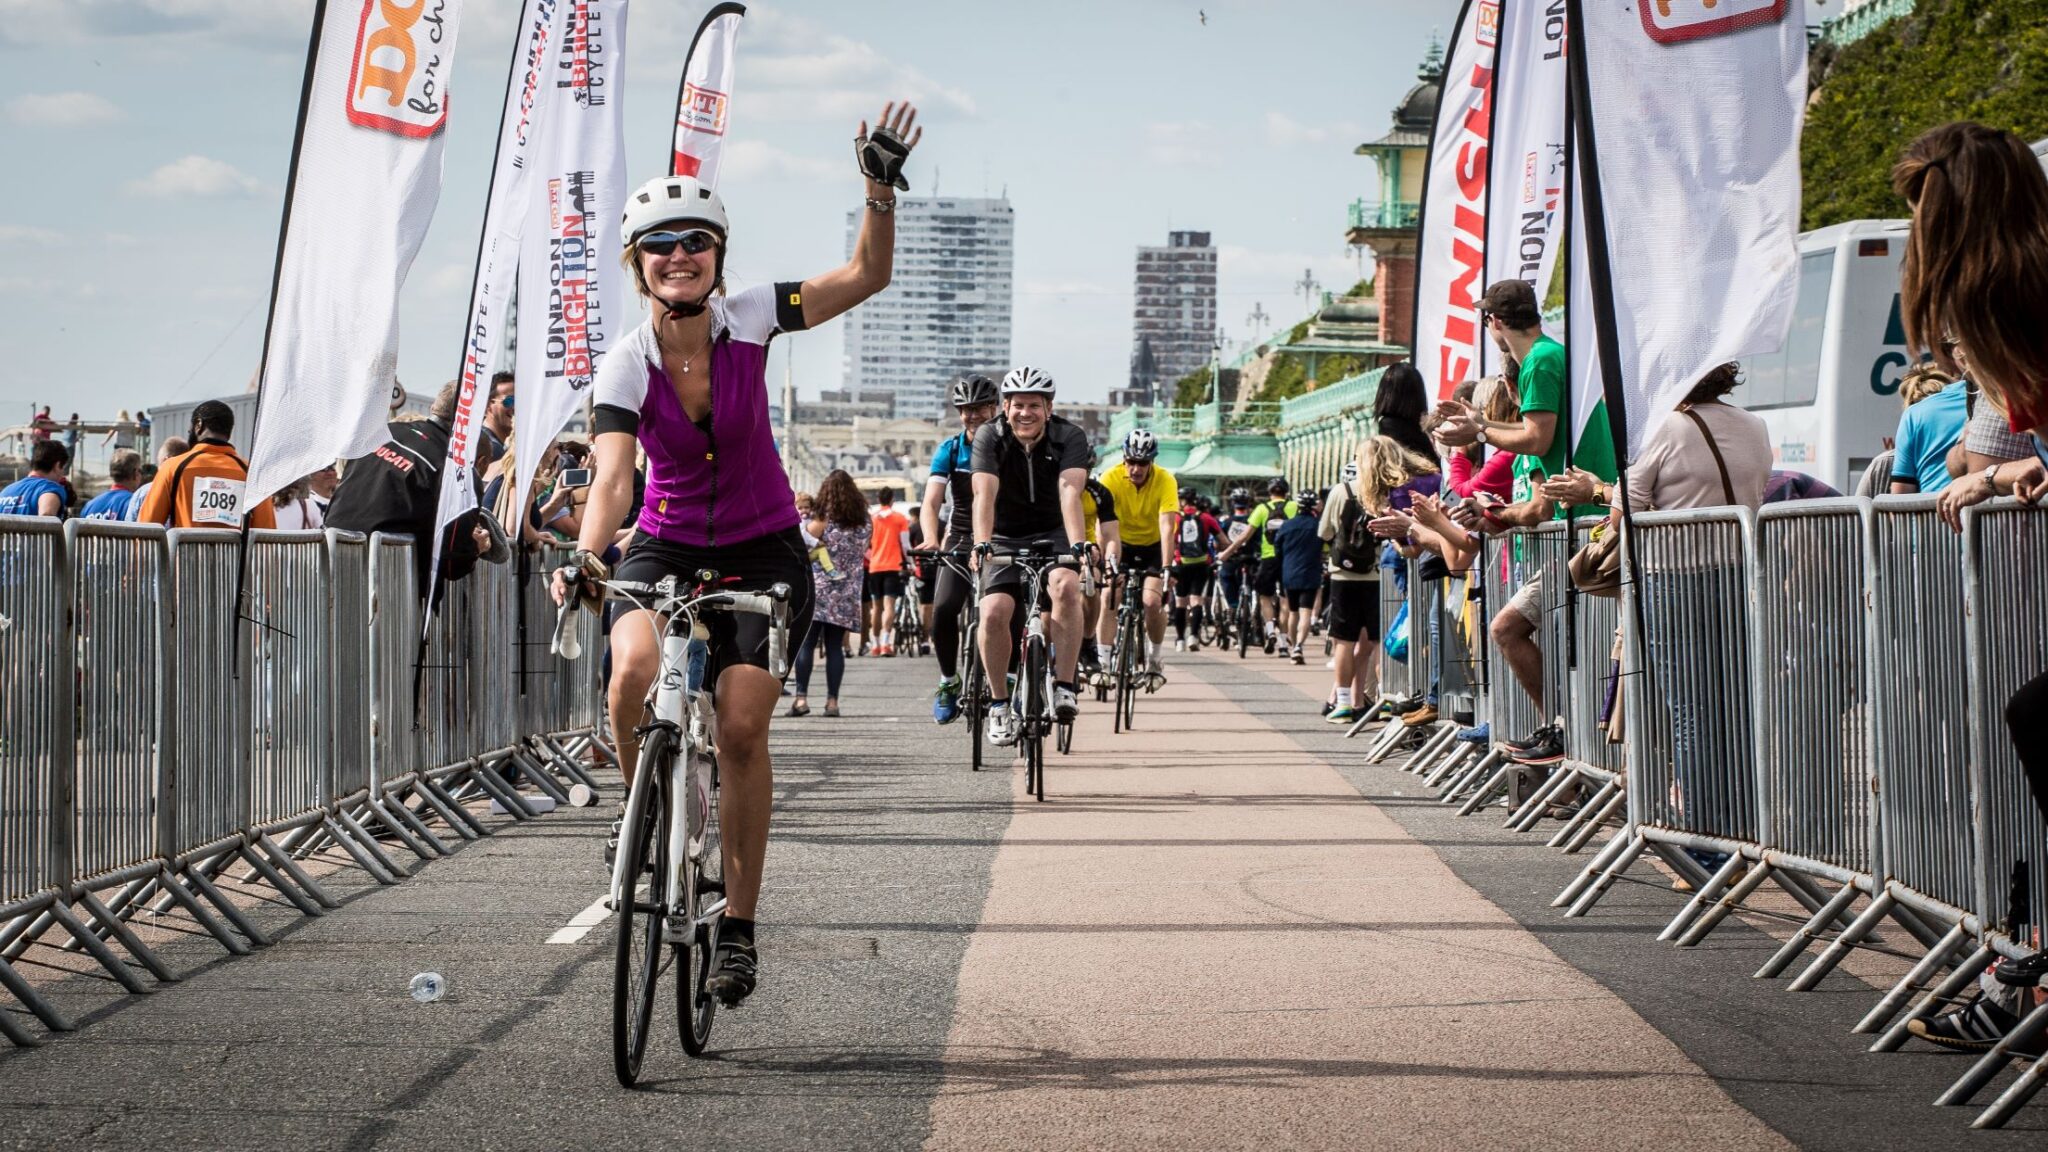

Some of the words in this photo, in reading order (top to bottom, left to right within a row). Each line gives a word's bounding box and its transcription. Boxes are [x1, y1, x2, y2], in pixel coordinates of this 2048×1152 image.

[588, 12, 604, 87] CYCLE
[585, 230, 598, 291] RIDE
[1438, 63, 1493, 401] FINISH
[545, 238, 567, 378] LONDON
[562, 215, 592, 377] BRIGHTON
[374, 446, 414, 472] UCATI
[200, 490, 237, 512] 2089
